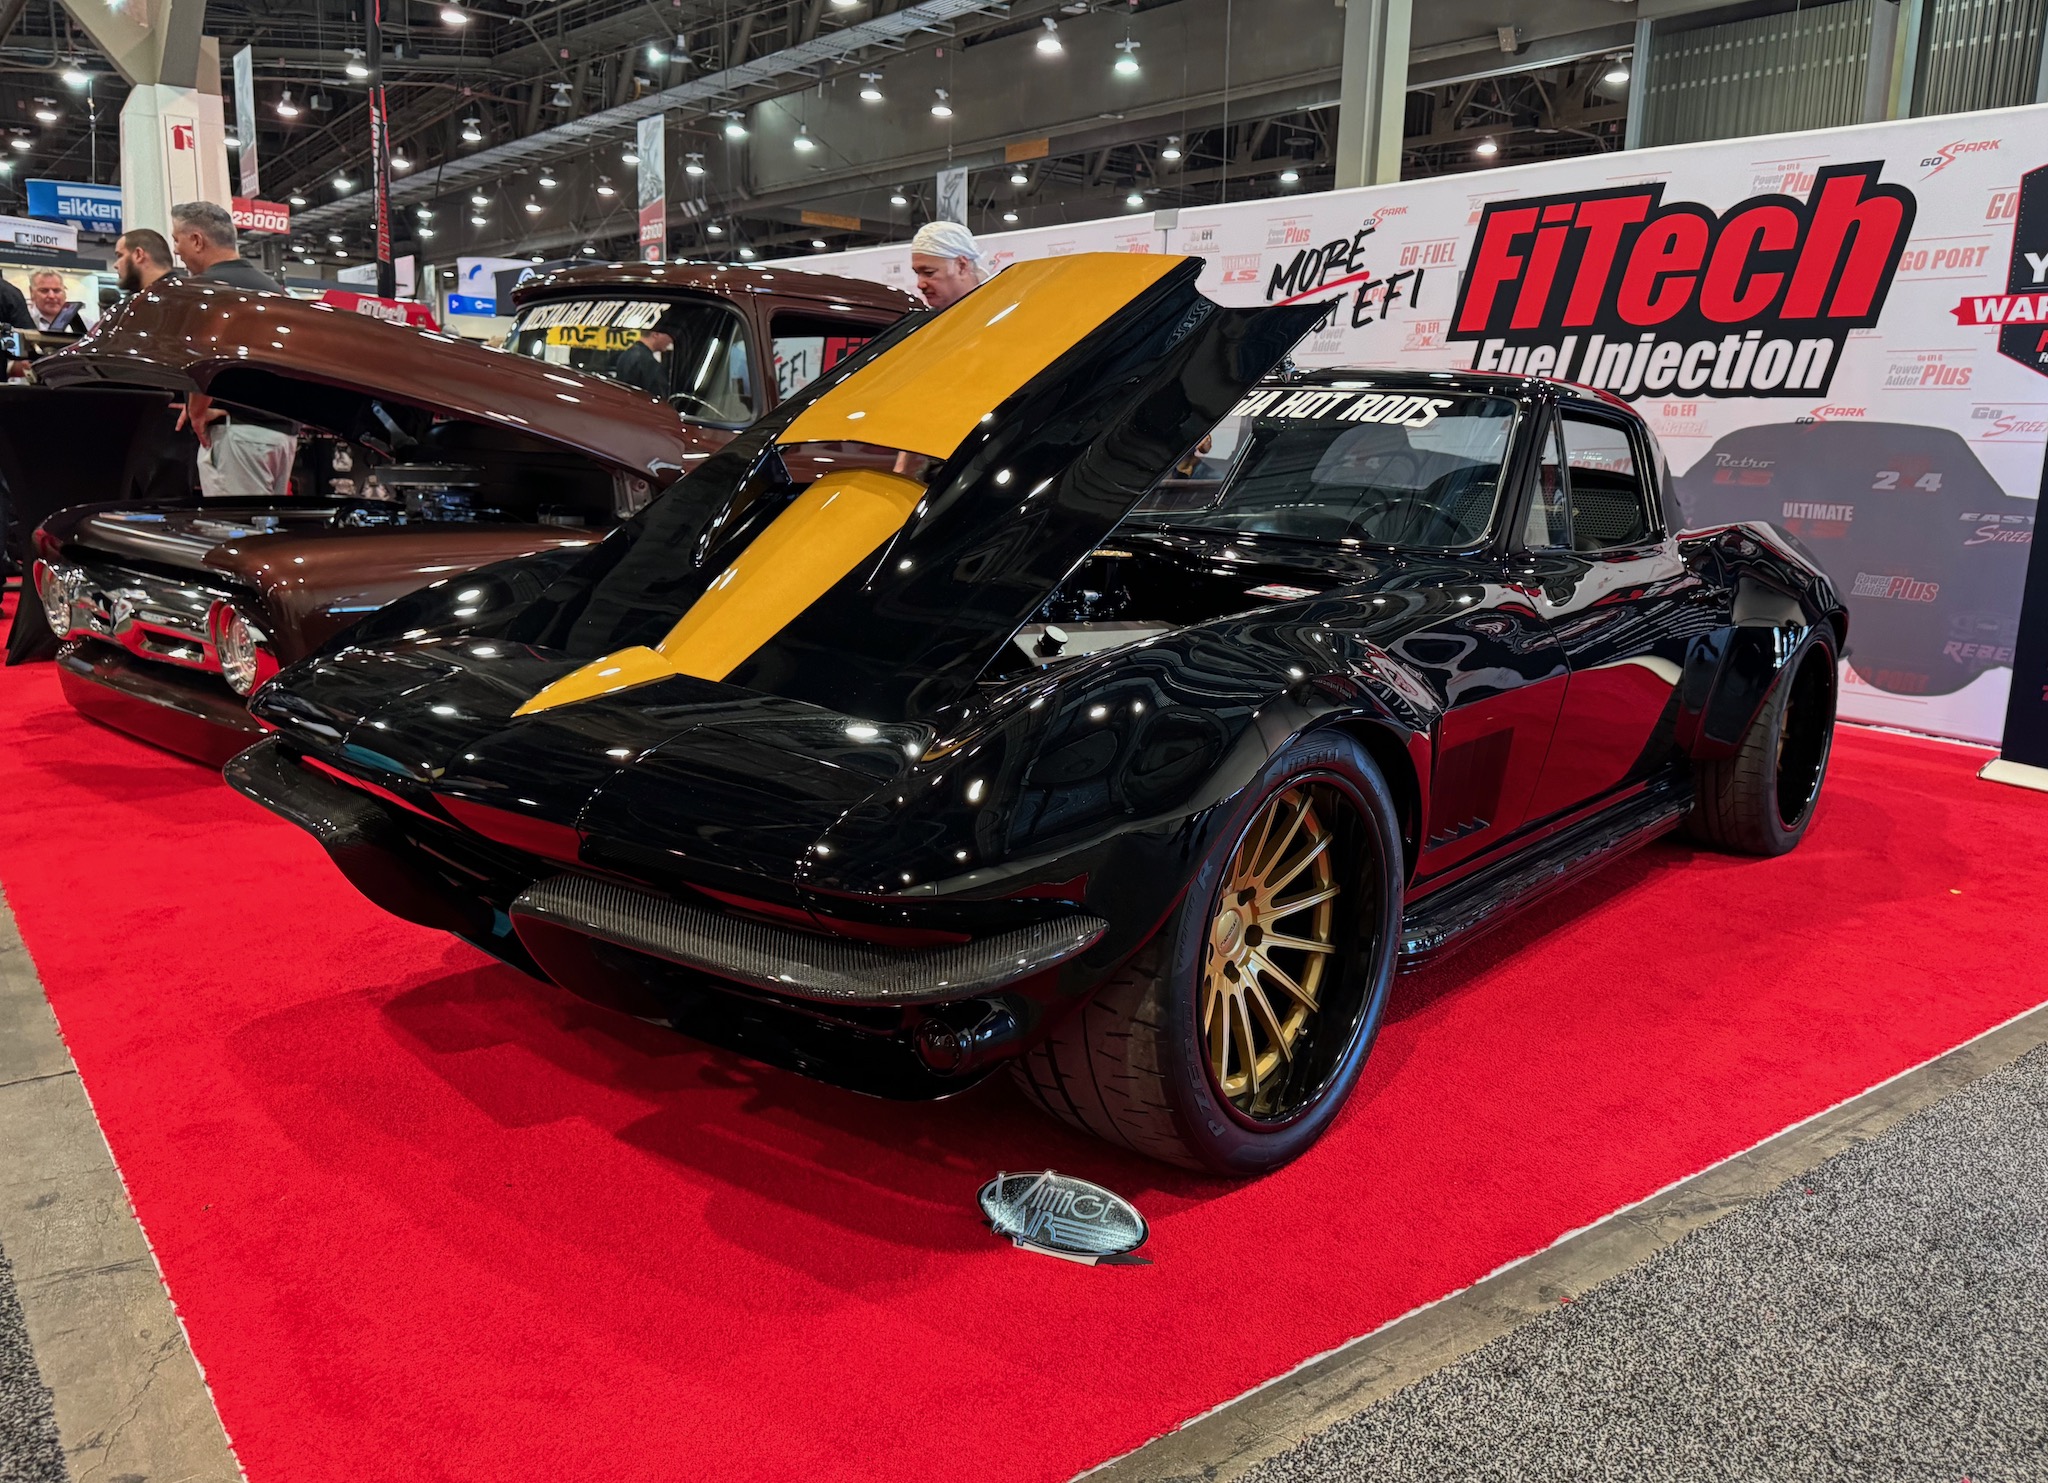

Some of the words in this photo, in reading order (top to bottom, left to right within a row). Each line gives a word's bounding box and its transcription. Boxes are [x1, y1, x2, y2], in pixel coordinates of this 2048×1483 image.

[1920, 157, 1942, 167] GO
[1780, 172, 1815, 193] Plu
[232, 211, 288, 231] 23000
[1284, 227, 1311, 244] Plus
[1400, 242, 1456, 266] GO-FUEL
[1457, 174, 1904, 332] FiTech
[1930, 246, 1990, 270] PORT
[1266, 227, 1376, 301] MORE
[1351, 268, 1424, 329] EFI
[519, 302, 594, 332] NOSTALGIA
[582, 301, 627, 327] HOT
[612, 303, 671, 330] RODS
[1428, 322, 1440, 333] EFI
[1478, 334, 1578, 382] Fuel
[1576, 329, 1834, 396] Injection
[1888, 364, 1923, 375] Power
[1885, 375, 1919, 386] Adder
[1919, 364, 1973, 385] Plus
[1266, 391, 1351, 420] HOT
[1336, 395, 1454, 428] RODS
[1663, 404, 1678, 416] Go
[1680, 404, 1697, 416] EFI
[1971, 407, 2002, 419] Go
[1716, 453, 1775, 468] Retro
[1782, 502, 1854, 521] ULTIMATE
[1854, 572, 1890, 586] Power
[1886, 576, 1939, 601] Plus
